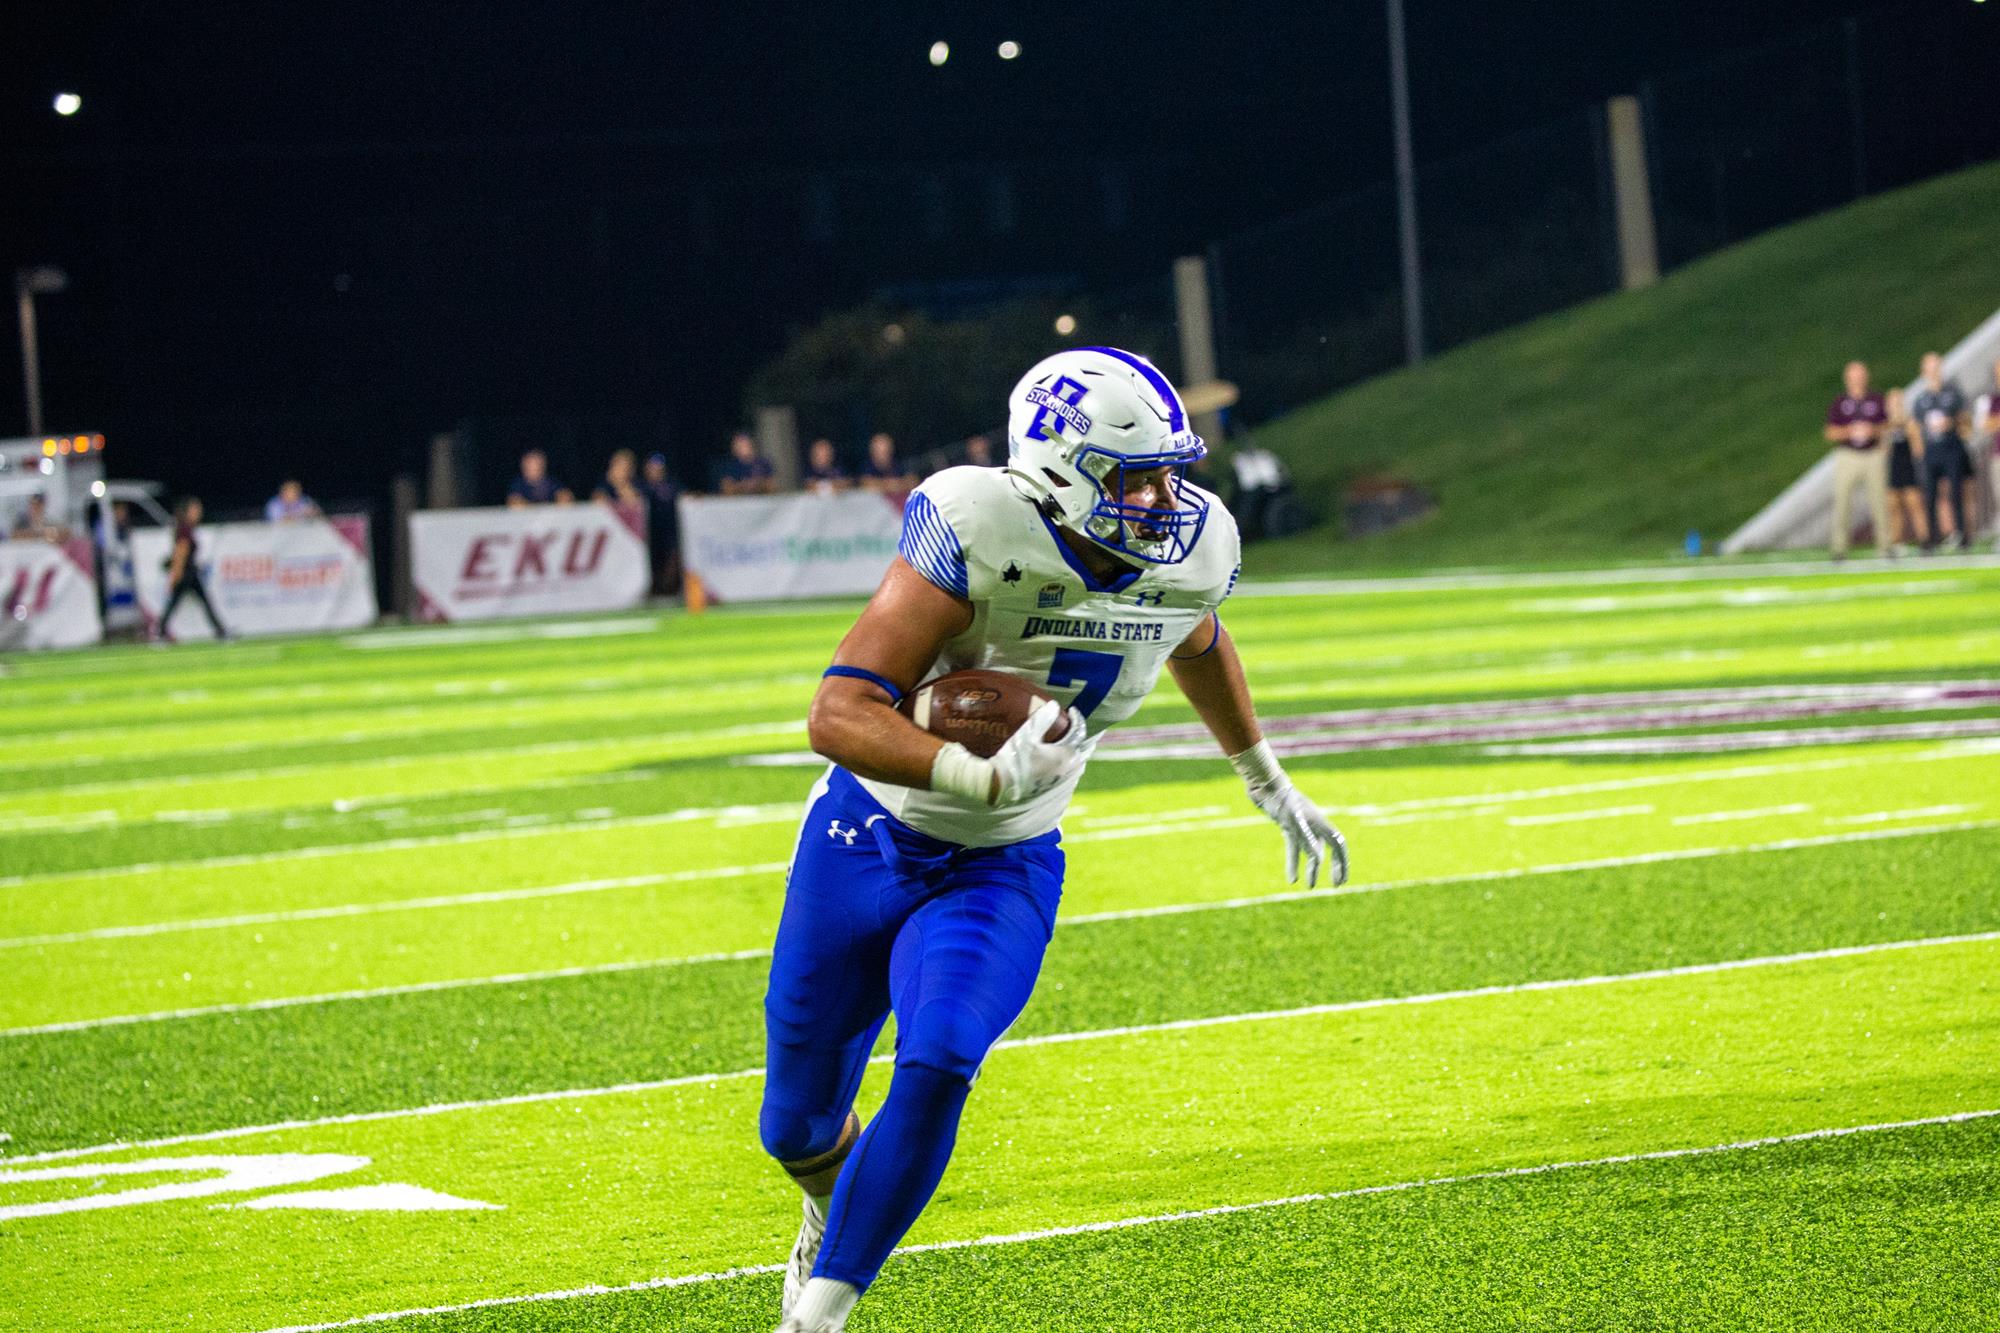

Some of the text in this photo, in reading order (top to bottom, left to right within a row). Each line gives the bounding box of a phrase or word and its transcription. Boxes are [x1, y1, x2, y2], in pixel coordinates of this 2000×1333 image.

[1027, 387, 1091, 434] SYCAMORES
[462, 529, 609, 579] EKU
[1021, 617, 1163, 640] INDIANA STATE
[1047, 647, 1124, 719] 7
